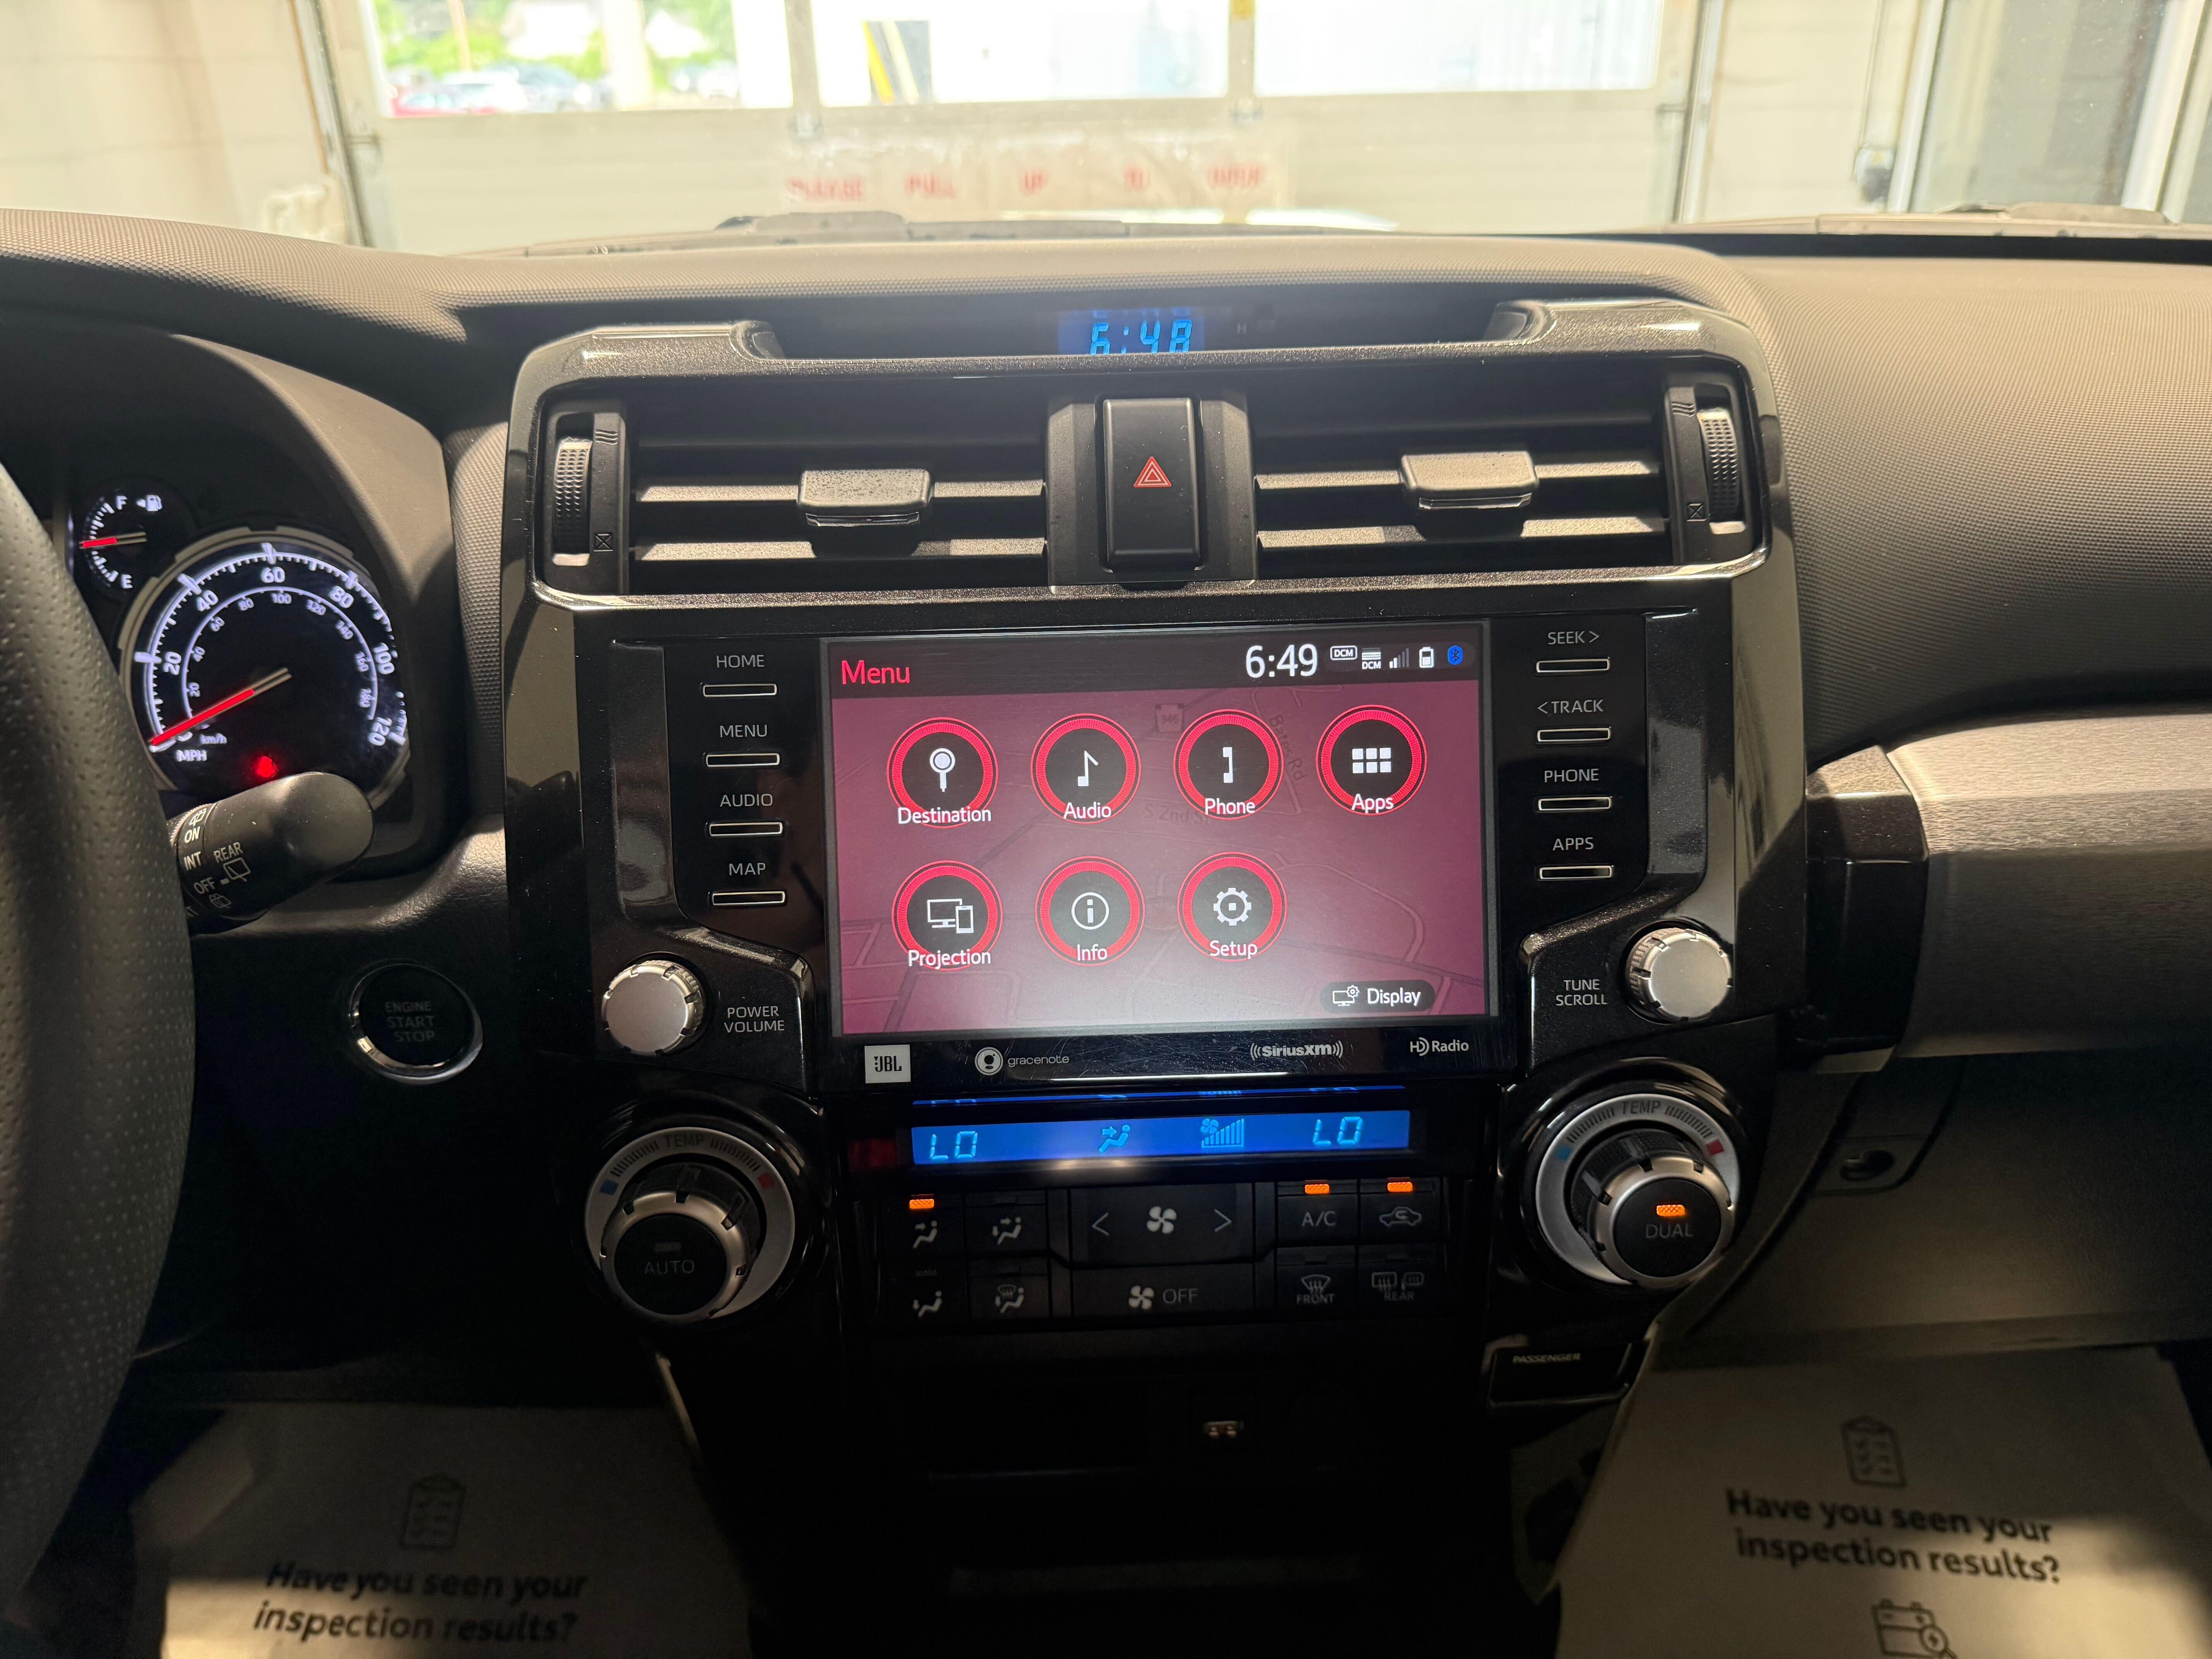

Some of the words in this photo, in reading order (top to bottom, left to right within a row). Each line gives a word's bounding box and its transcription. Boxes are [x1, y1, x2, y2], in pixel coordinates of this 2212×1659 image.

[1090, 319, 1192, 356] 6:48
[115, 496, 127, 510] F
[120, 574, 132, 589] E
[261, 566, 286, 583] 60
[196, 589, 219, 612] 40
[238, 598, 254, 611] 80
[271, 592, 292, 605] 100
[329, 585, 354, 609] 80
[306, 599, 326, 616] 120
[210, 616, 225, 632] 60
[335, 619, 354, 640] 140
[193, 646, 206, 663] 40
[354, 651, 369, 672] 160
[373, 642, 395, 675] 100
[716, 654, 765, 668] HOME
[1245, 643, 1317, 678] 6:49
[1334, 649, 1353, 658] DCM
[161, 651, 183, 676] 20
[842, 659, 910, 685] Menu
[1362, 661, 1381, 670] DCM
[189, 682, 201, 697] 20
[200, 732, 227, 744] km/h
[368, 716, 393, 746] 120
[720, 724, 768, 738] MENU
[176, 749, 208, 762] MPH
[1287, 758, 1308, 781] Rd
[1544, 768, 1599, 783] PHONE
[720, 793, 774, 807] AUDIO
[1205, 798, 1256, 815] Phone
[1351, 793, 1394, 814] Apps
[898, 806, 992, 824] Destination
[1063, 801, 1112, 820] Audio
[184, 826, 201, 843] ON
[1553, 836, 1594, 851] APPS
[184, 851, 201, 871] INT
[214, 842, 244, 863] REAR
[728, 862, 766, 876] MAP
[194, 877, 215, 894] OFF
[1077, 944, 1108, 962] Info
[1209, 940, 1259, 960] Setup
[907, 949, 992, 970] Projection
[1563, 979, 1600, 991] TUNE
[385, 1000, 432, 1013] ENGINE
[1367, 988, 1422, 1008] Display
[1555, 994, 1608, 1006] SCROLL
[727, 1006, 779, 1019] POWER
[386, 1015, 434, 1028] START
[724, 1020, 785, 1033] VOLUME
[394, 1030, 434, 1042] STOP
[1410, 1037, 1430, 1056] HD
[1431, 1039, 1469, 1052] Radio
[874, 1055, 902, 1072] JBL
[1008, 1054, 1070, 1068] gracenote
[1620, 1100, 1661, 1115] TEMP
[1313, 1116, 1363, 1146] LO
[663, 1133, 704, 1148] TEMP
[929, 1131, 978, 1160] LO
[1302, 1211, 1336, 1227] A/C
[1645, 1224, 1693, 1239] DUAL
[644, 1259, 695, 1274] AUTO
[1163, 1288, 1198, 1304] OFF
[1297, 1293, 1335, 1305] FRONT
[1384, 1291, 1415, 1301] REAR
[1512, 1353, 1581, 1364] PASSENGER
[1725, 1489, 1811, 1521] Have
[1818, 1498, 1882, 1528] you
[1891, 1504, 1972, 1534] seen
[1980, 1512, 2052, 1544] your
[1735, 1527, 1921, 1570] inspection
[1929, 1546, 2061, 1584] results?
[266, 1561, 350, 1594] Have
[352, 1566, 414, 1599] you
[422, 1570, 503, 1597] seen
[511, 1574, 589, 1607] your
[253, 1600, 434, 1642] inspection
[444, 1611, 579, 1644] results?
